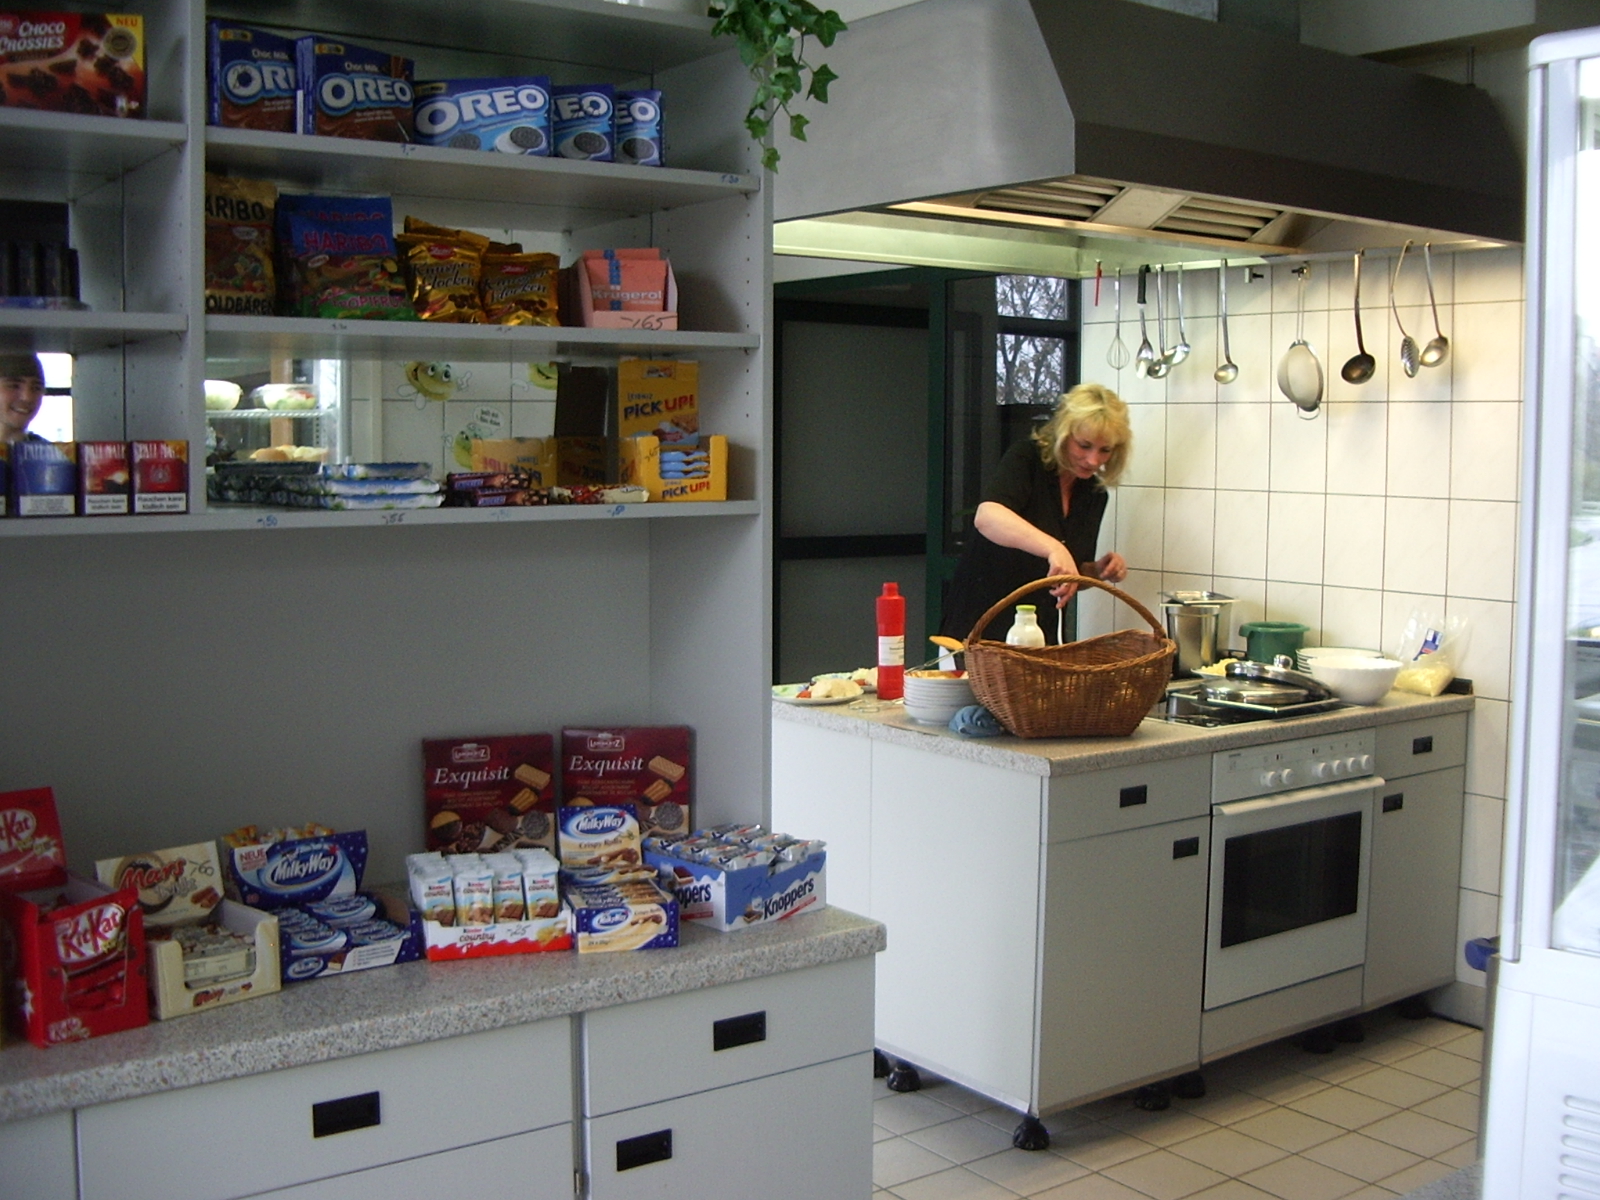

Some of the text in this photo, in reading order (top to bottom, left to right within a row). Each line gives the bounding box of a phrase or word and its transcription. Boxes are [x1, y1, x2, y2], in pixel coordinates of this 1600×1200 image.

[116, 17, 138, 27] NEU
[321, 77, 412, 108] OREO
[415, 88, 545, 135] OREO
[552, 96, 608, 122] EO
[303, 230, 387, 253] HARIBO
[664, 394, 695, 412] UP!
[690, 481, 710, 493] UP!
[434, 765, 511, 789] Exquisit
[569, 754, 645, 777] Exquisit
[240, 848, 266, 862] NEUE
[119, 857, 187, 888] Mars
[763, 877, 815, 920] Knoppers
[61, 907, 122, 959] KitKat
[459, 932, 496, 944] country
